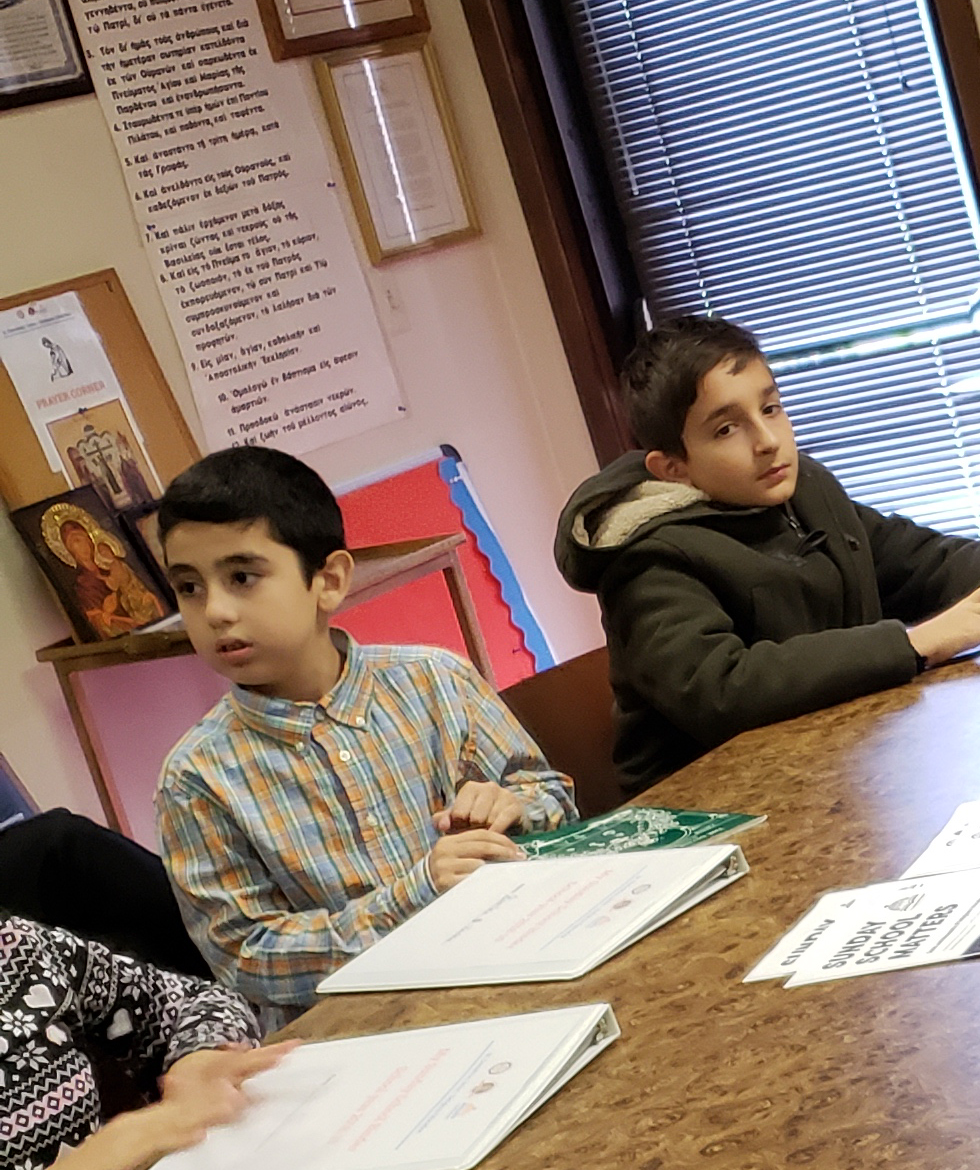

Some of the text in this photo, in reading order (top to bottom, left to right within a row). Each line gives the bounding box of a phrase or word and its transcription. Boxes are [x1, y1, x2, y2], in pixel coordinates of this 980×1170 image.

[36, 380, 105, 410] PRAYER CORNER
[822, 921, 886, 969] SUNDAY
[855, 913, 922, 965] SCHOOL
[888, 904, 958, 960] MATTERS
